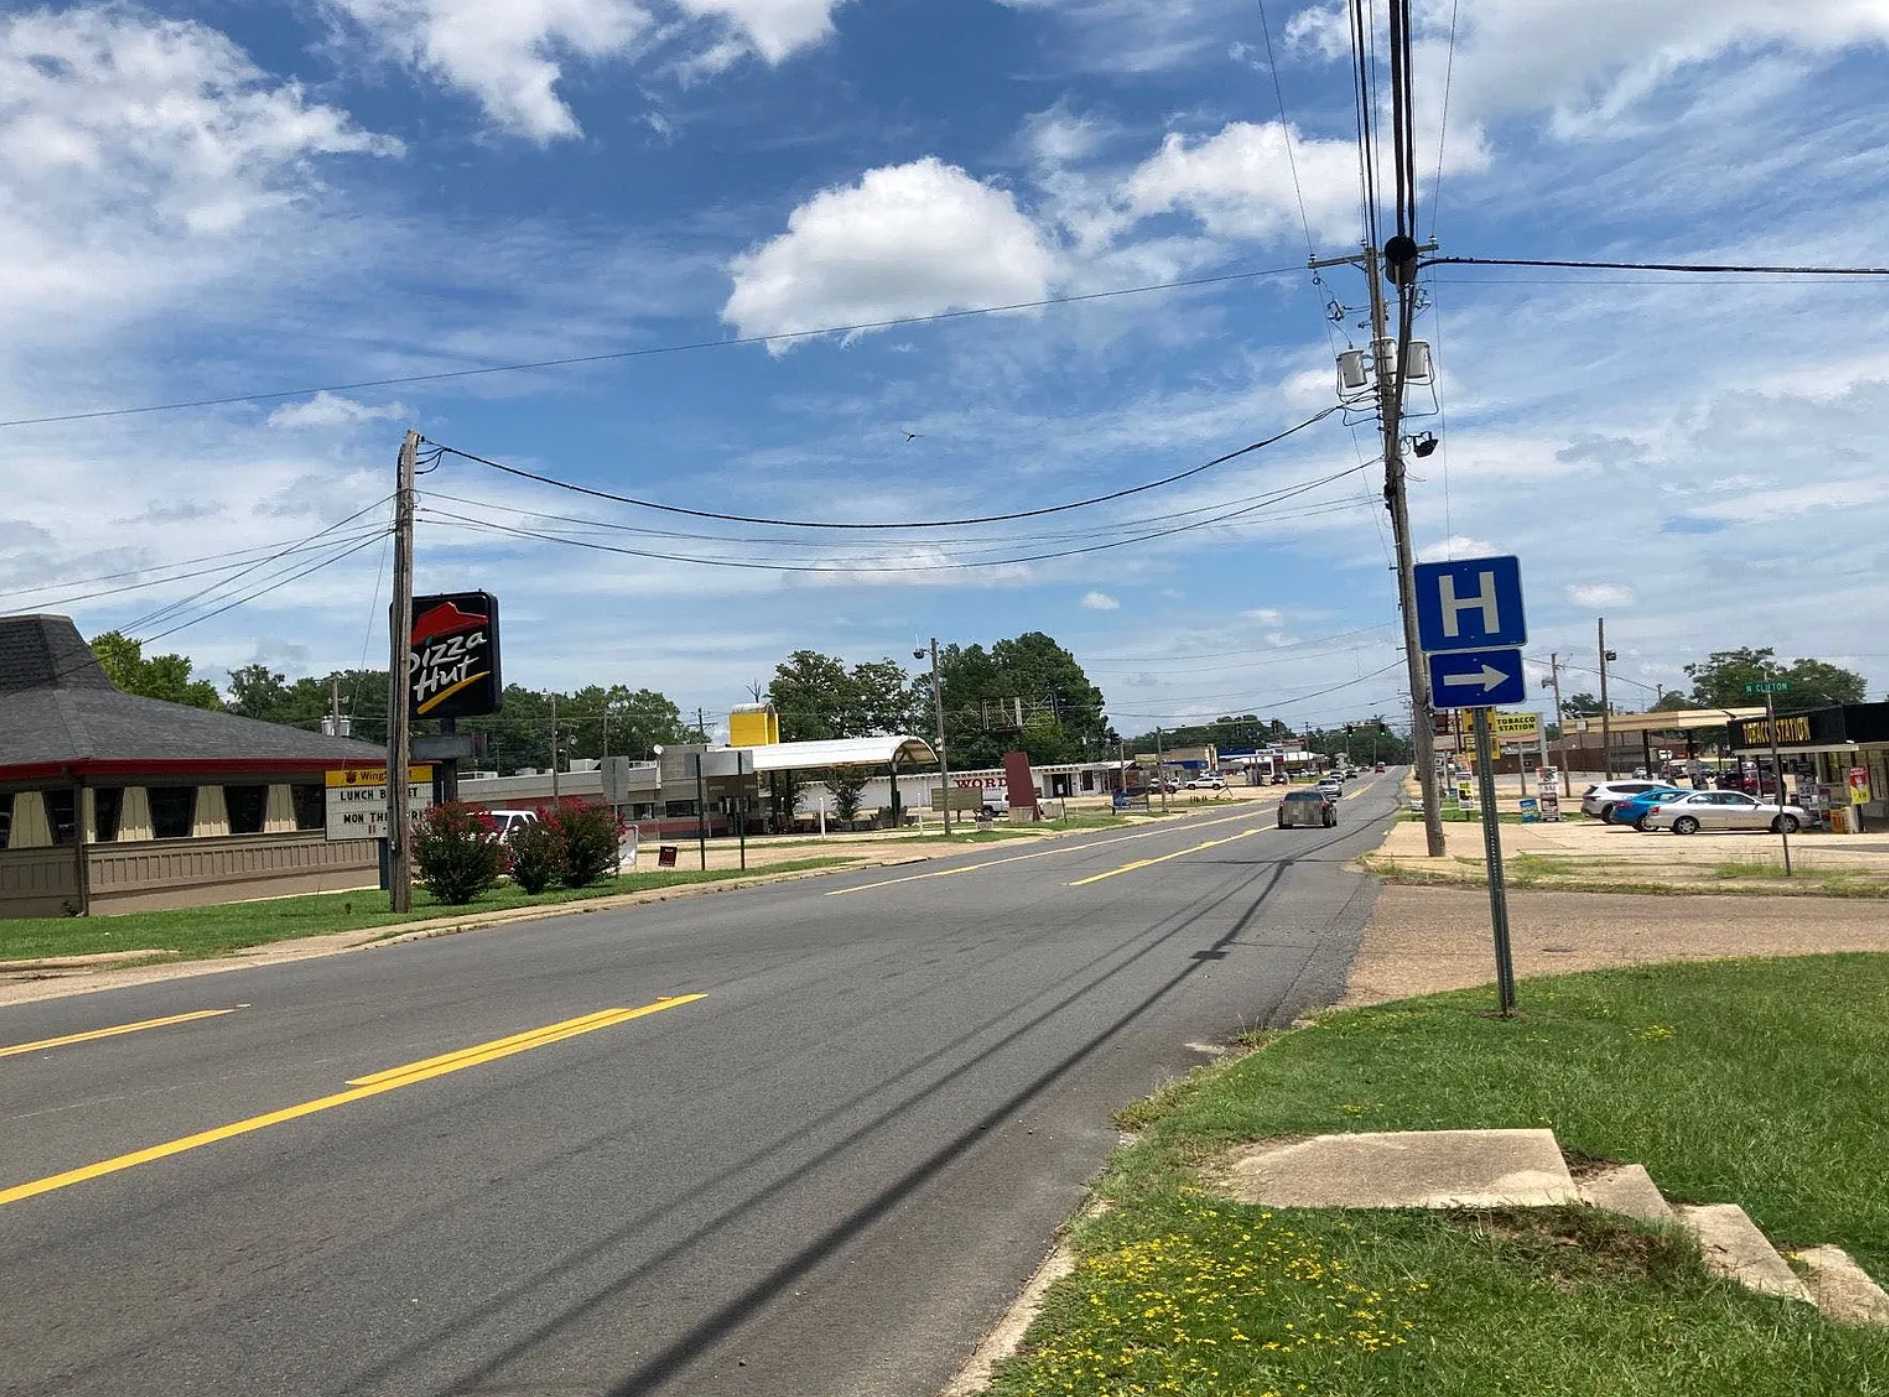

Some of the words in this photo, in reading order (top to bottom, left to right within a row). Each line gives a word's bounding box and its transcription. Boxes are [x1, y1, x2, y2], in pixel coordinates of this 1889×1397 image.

[1438, 571, 1500, 637] H
[413, 655, 479, 701] Hut
[1497, 716, 1536, 725] TOBACCO
[1499, 723, 1535, 732] STATION
[1743, 721, 1771, 745] TOBACC
[1775, 717, 1809, 743] STATION
[953, 778, 1007, 788] WORD
[341, 789, 374, 801] LUNCH
[380, 787, 418, 800] BET
[344, 814, 364, 823] MON
[408, 810, 422, 820] RI
